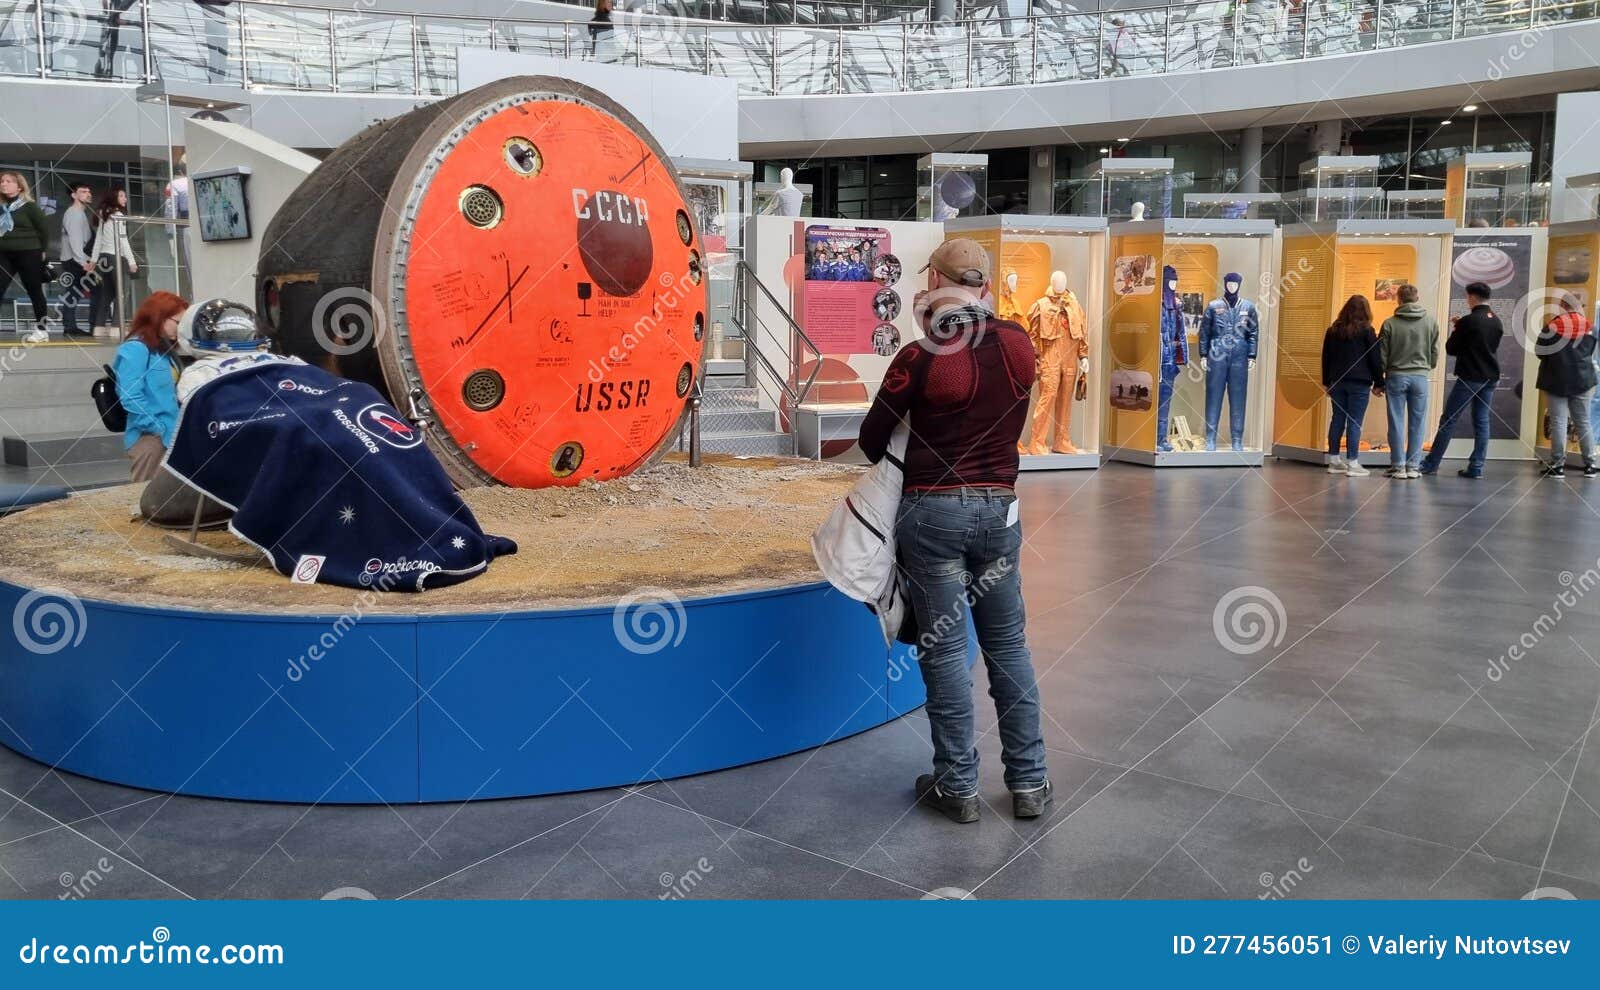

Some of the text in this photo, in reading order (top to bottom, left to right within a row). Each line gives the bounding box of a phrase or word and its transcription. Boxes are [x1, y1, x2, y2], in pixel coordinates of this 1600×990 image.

[572, 188, 648, 226] СССР
[575, 379, 651, 412] USSR
[332, 408, 380, 454] ROSCOSMOS
